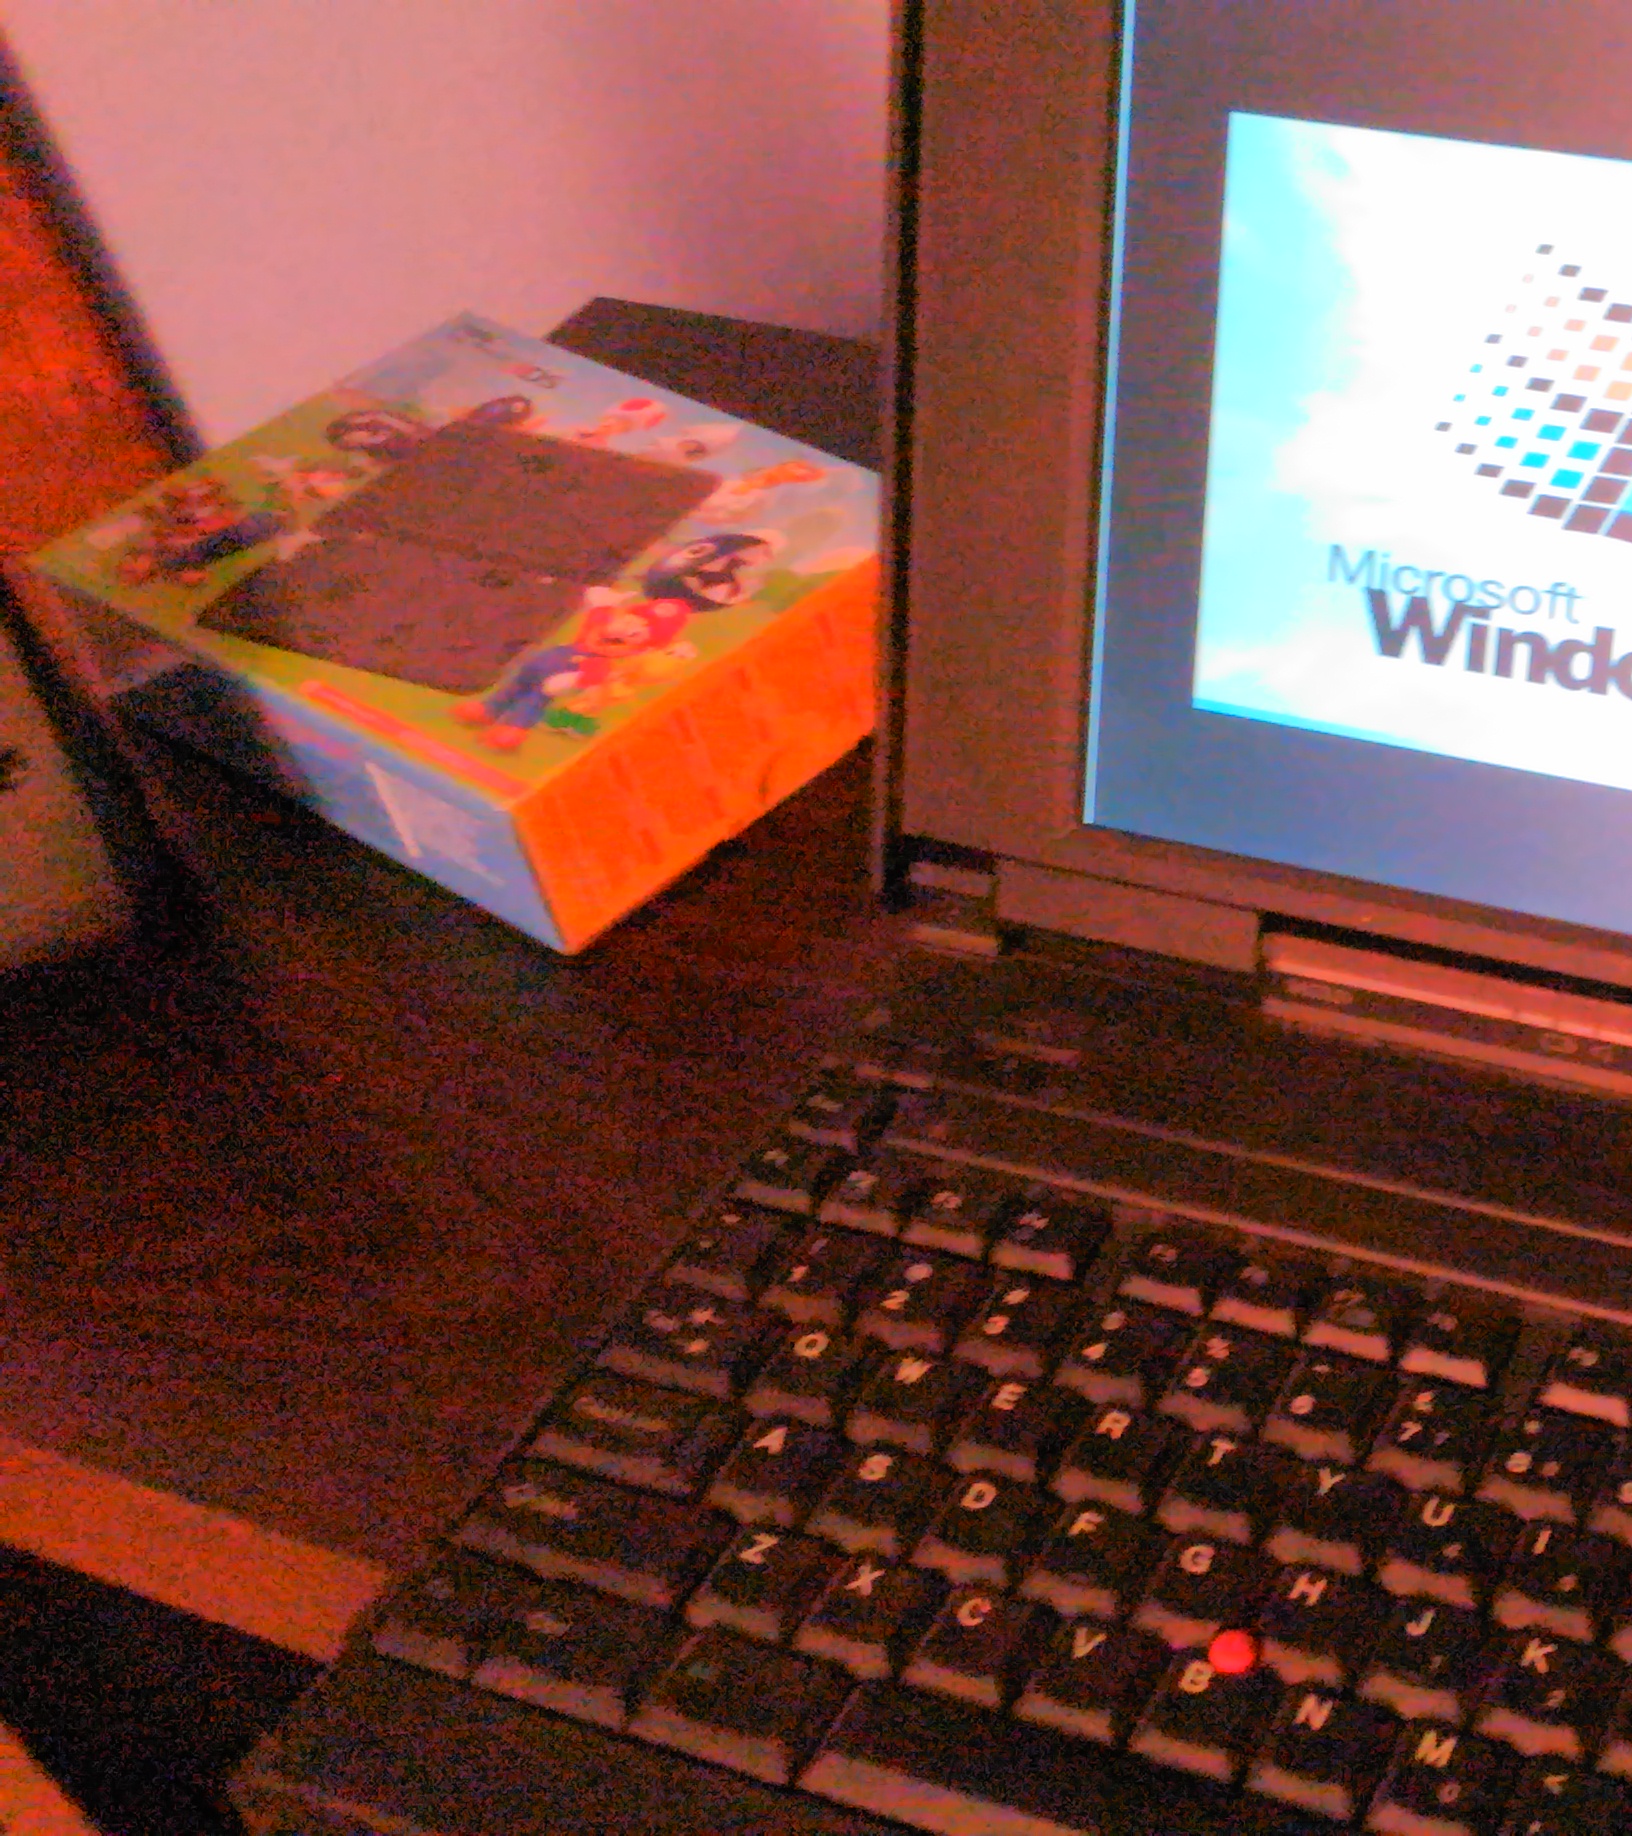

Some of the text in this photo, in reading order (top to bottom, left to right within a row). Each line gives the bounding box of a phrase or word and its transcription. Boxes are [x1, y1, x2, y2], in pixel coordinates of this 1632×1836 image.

[1326, 543, 1587, 625] Microsoft
[991, 1381, 1026, 1412] E
[1095, 1409, 1132, 1441] R
[1206, 1436, 1238, 1467] T
[1317, 1465, 1347, 1497] Y
[1420, 1496, 1456, 1528] U
[752, 1426, 788, 1455] A
[960, 1480, 998, 1511] D
[1068, 1510, 1104, 1538] F
[1179, 1544, 1216, 1575] G
[1287, 1573, 1328, 1606] H
[1405, 1609, 1435, 1638] J
[1521, 1637, 1556, 1675] K
[738, 1532, 780, 1565] Z
[845, 1563, 885, 1597] X
[956, 1595, 993, 1628] C
[1072, 1626, 1108, 1660] V
[1294, 1693, 1333, 1732] N
[1415, 1730, 1457, 1768] M
